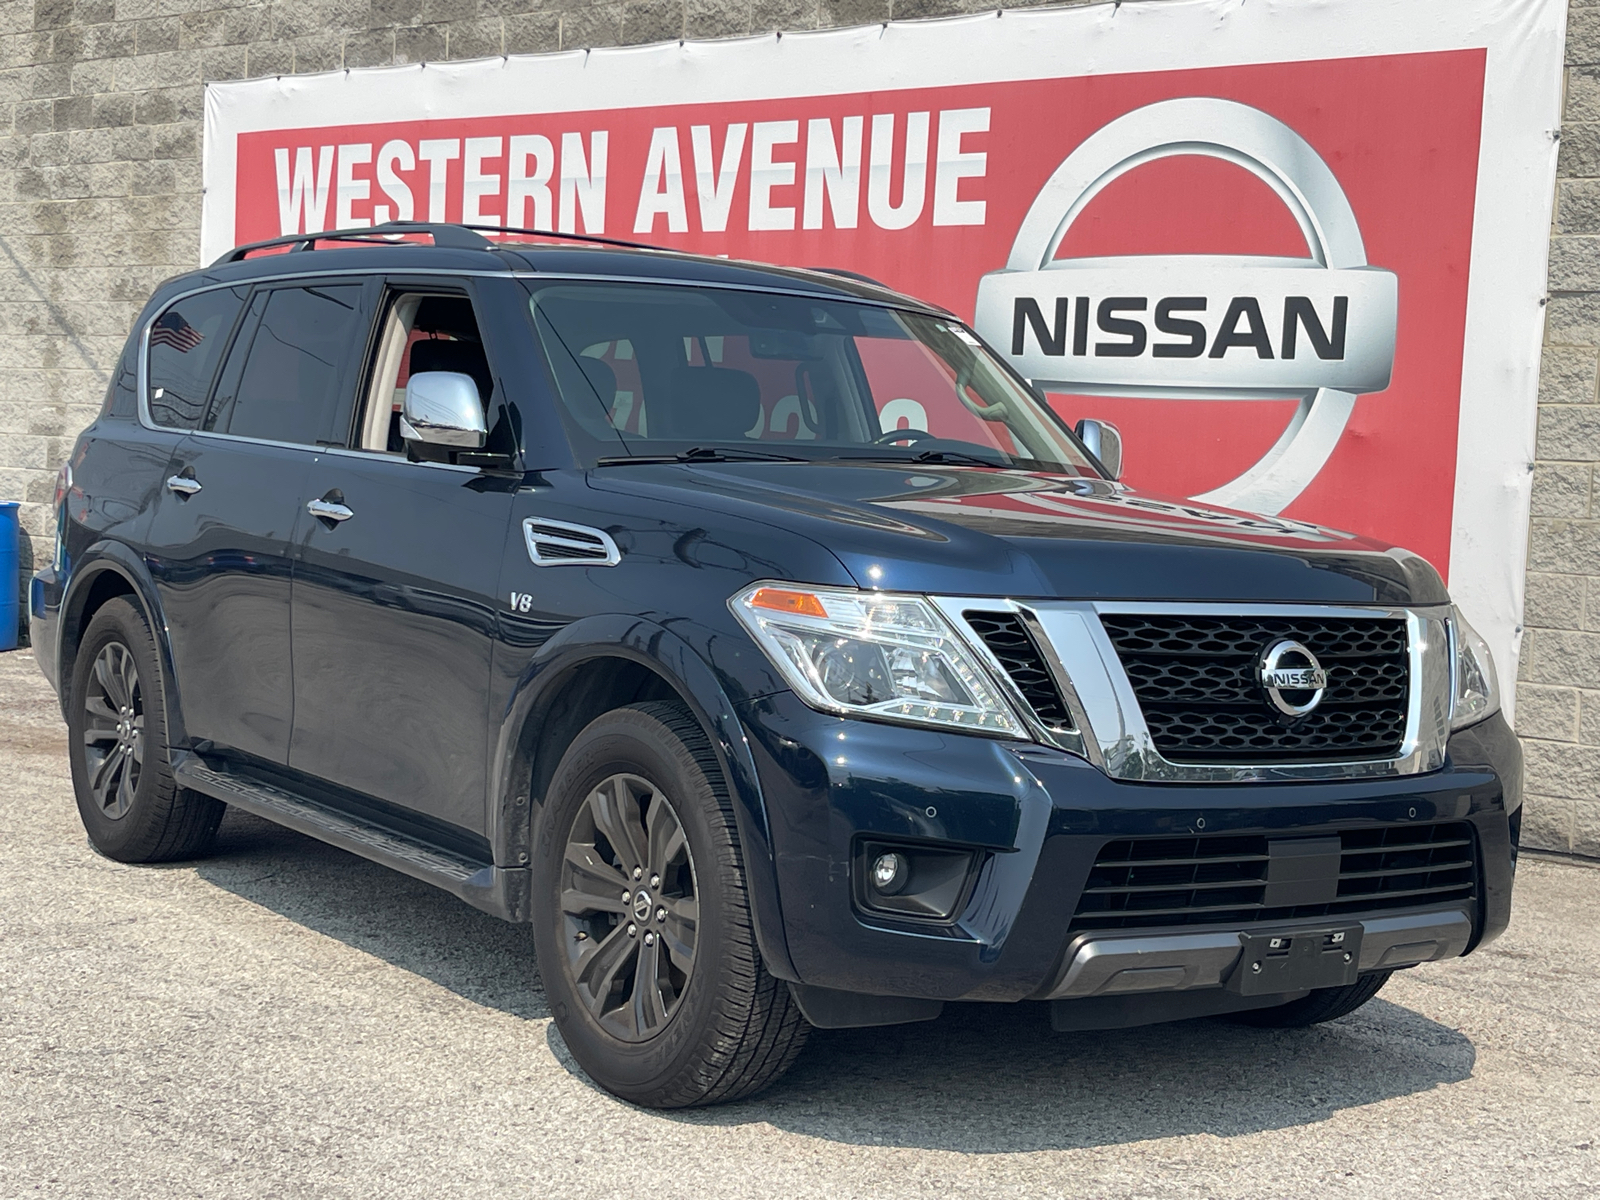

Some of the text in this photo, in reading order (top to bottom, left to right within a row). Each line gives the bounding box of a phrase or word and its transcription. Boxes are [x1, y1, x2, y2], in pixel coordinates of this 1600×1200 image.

[274, 107, 992, 238] WESTERN AVENUE
[1012, 296, 1349, 360] NISSAN
[510, 591, 533, 613] V8
[1273, 673, 1324, 685] NISSAN
